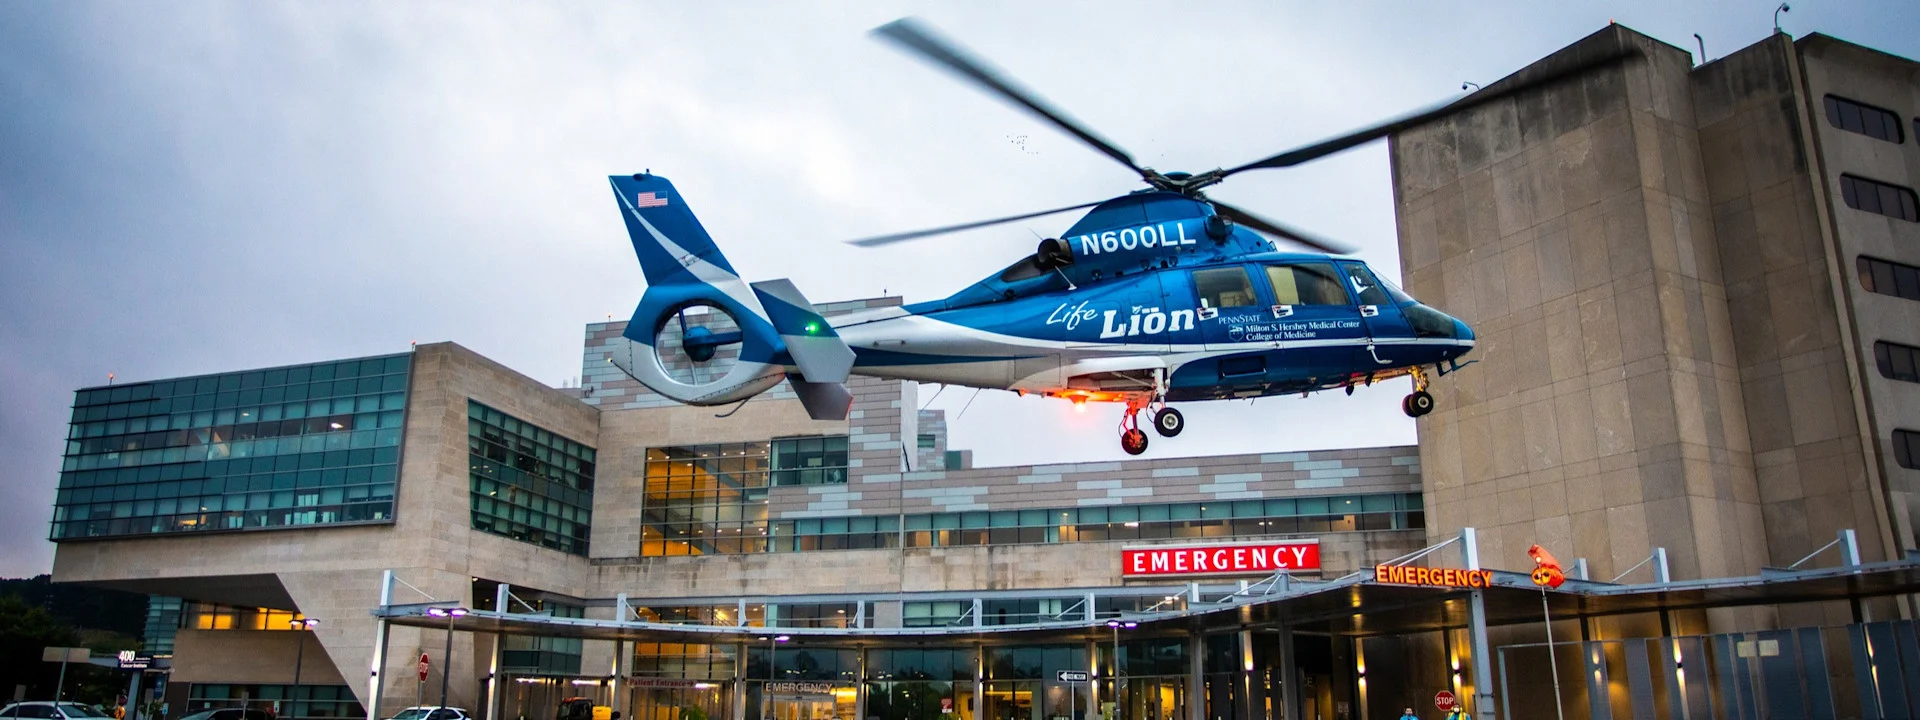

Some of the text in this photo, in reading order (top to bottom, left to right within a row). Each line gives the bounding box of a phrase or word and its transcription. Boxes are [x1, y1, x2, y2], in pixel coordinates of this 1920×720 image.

[1080, 222, 1197, 255] N600LL
[1046, 300, 1098, 331] Life
[1245, 320, 1360, 333] Milton S. Hershey Medical Center
[1245, 330, 1317, 341] College of Medicine
[1133, 547, 1307, 572] EMERGENCY
[1376, 565, 1493, 588] EMERGENCY
[119, 650, 135, 662] 400
[629, 679, 654, 687] Patient
[765, 682, 832, 693] EMERGENCY
[1436, 696, 1454, 705] STOP
